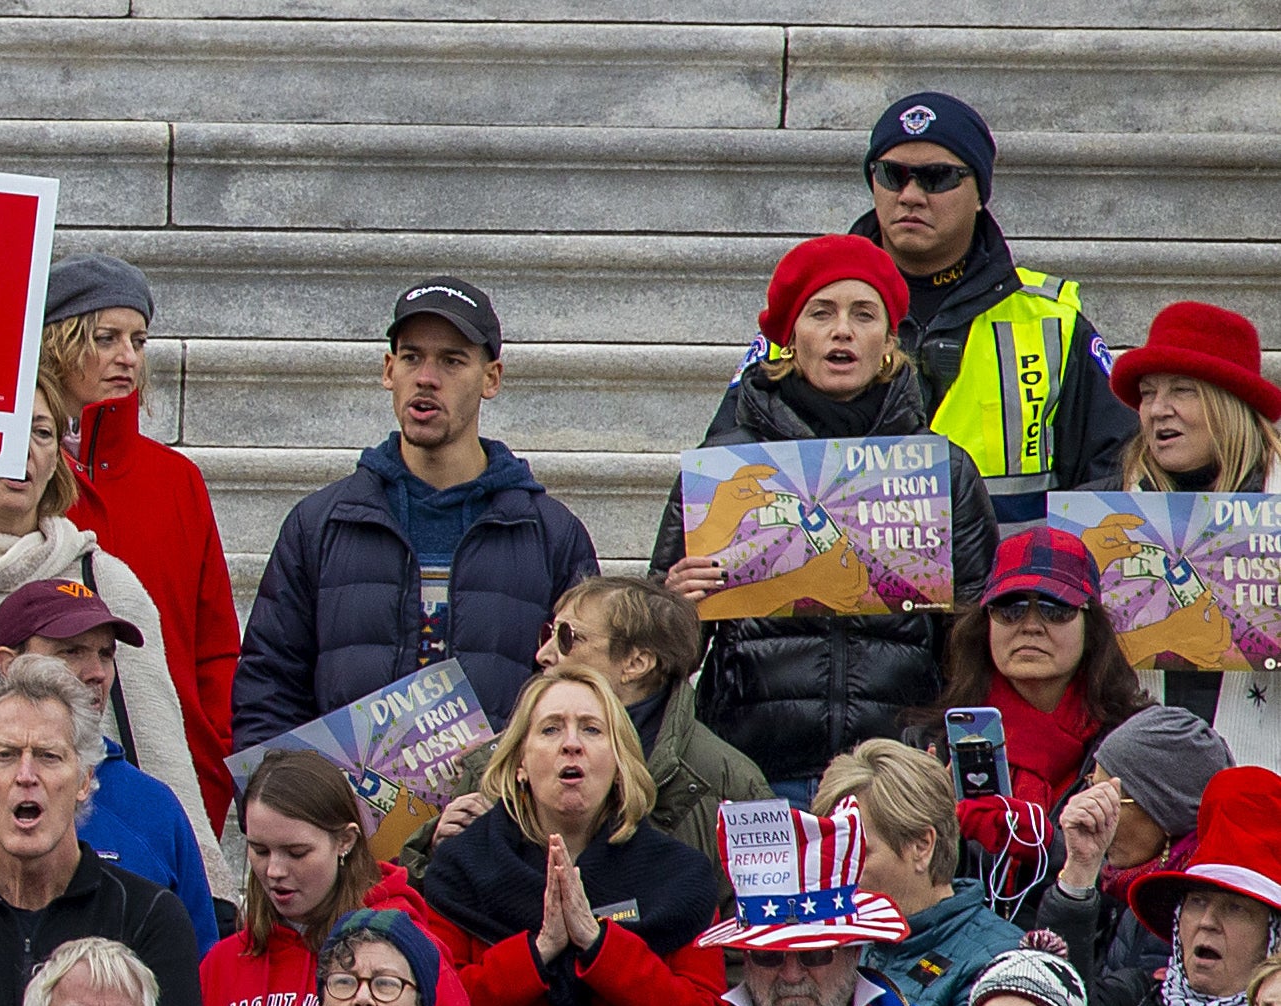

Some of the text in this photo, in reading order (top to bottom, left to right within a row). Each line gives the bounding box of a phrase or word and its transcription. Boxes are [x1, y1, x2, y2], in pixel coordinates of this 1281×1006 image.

[1021, 354, 1045, 457] POLICE
[846, 443, 937, 472] DIVEST
[882, 475, 938, 496] FROM
[858, 498, 938, 526] FOSSIL
[871, 526, 941, 550] FUELS
[370, 667, 455, 726] DIVEST
[415, 696, 468, 735] FROM
[401, 720, 480, 772] FOSSIL
[730, 830, 790, 846] VETERAN
[734, 851, 790, 867] REMOVE
[737, 871, 791, 887] THE GOP
